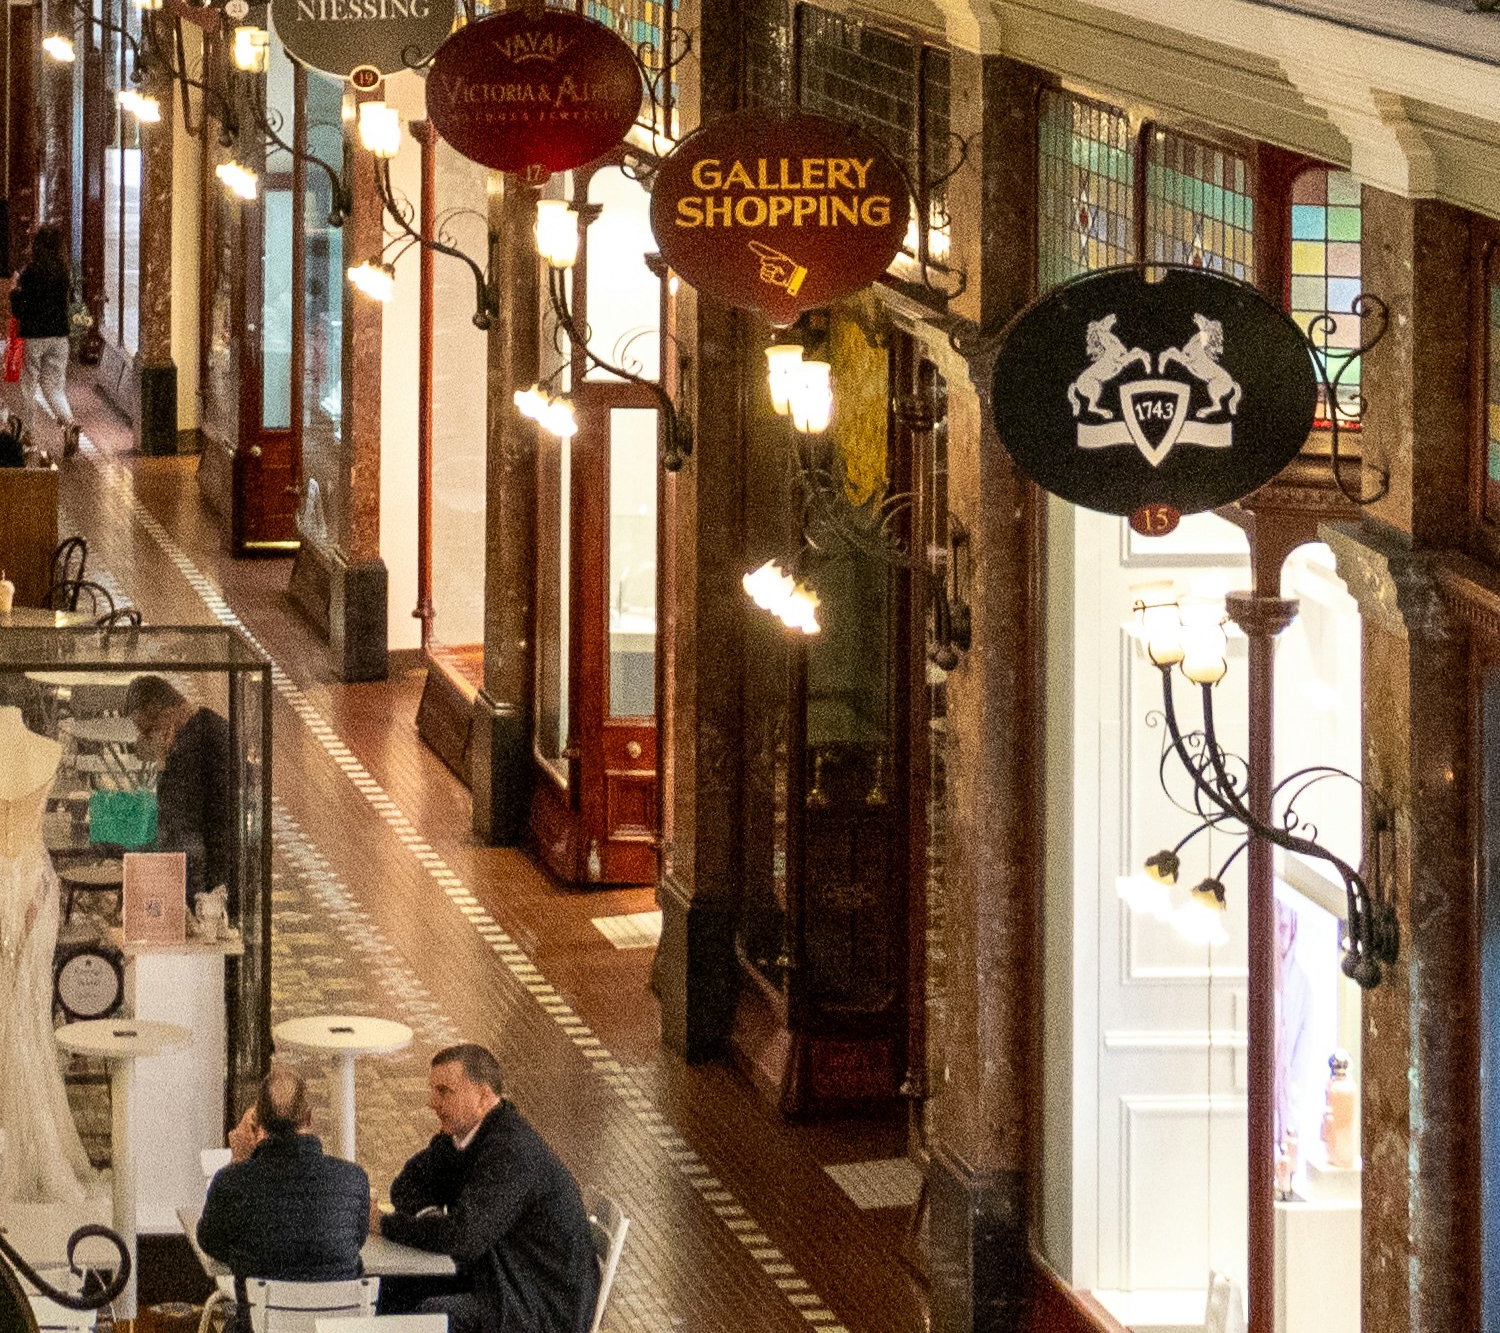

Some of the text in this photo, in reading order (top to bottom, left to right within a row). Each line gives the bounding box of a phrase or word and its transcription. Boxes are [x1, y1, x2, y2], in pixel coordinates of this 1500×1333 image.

[357, 70, 375, 85] 19
[440, 75, 536, 106] VICTORIA
[691, 158, 874, 190] GALLERY
[675, 195, 891, 227] SHOPPING
[1134, 400, 1174, 421] 1743
[1144, 508, 1169, 532] 15
